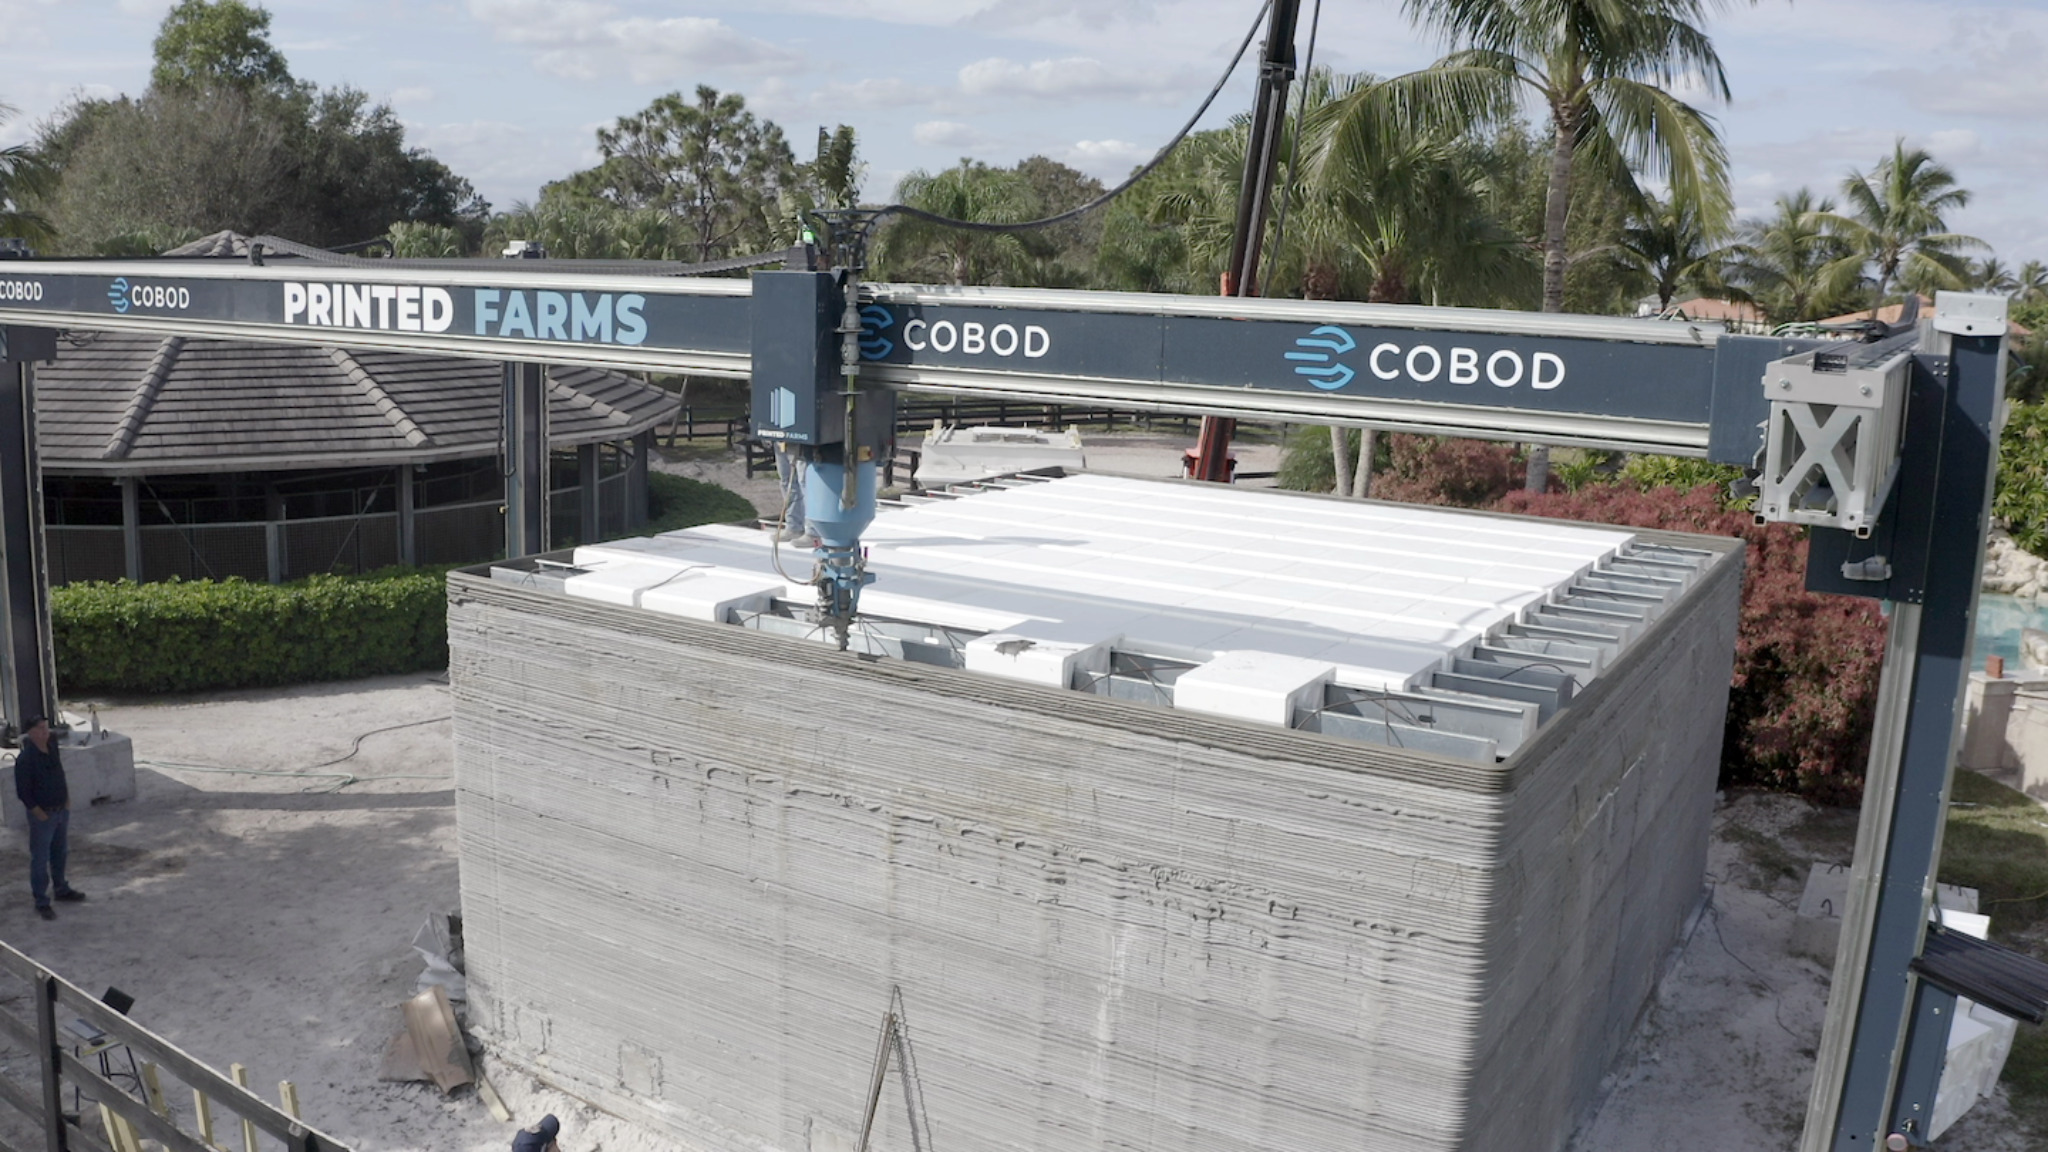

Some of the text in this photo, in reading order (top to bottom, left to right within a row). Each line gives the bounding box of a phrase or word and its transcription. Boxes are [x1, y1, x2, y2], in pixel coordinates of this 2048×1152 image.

[0, 280, 43, 301] COBOD
[131, 285, 190, 309] COBOD
[283, 282, 648, 346] PRINTED FARMS
[903, 318, 1050, 358] COBOD
[1369, 342, 1566, 390] COBOD
